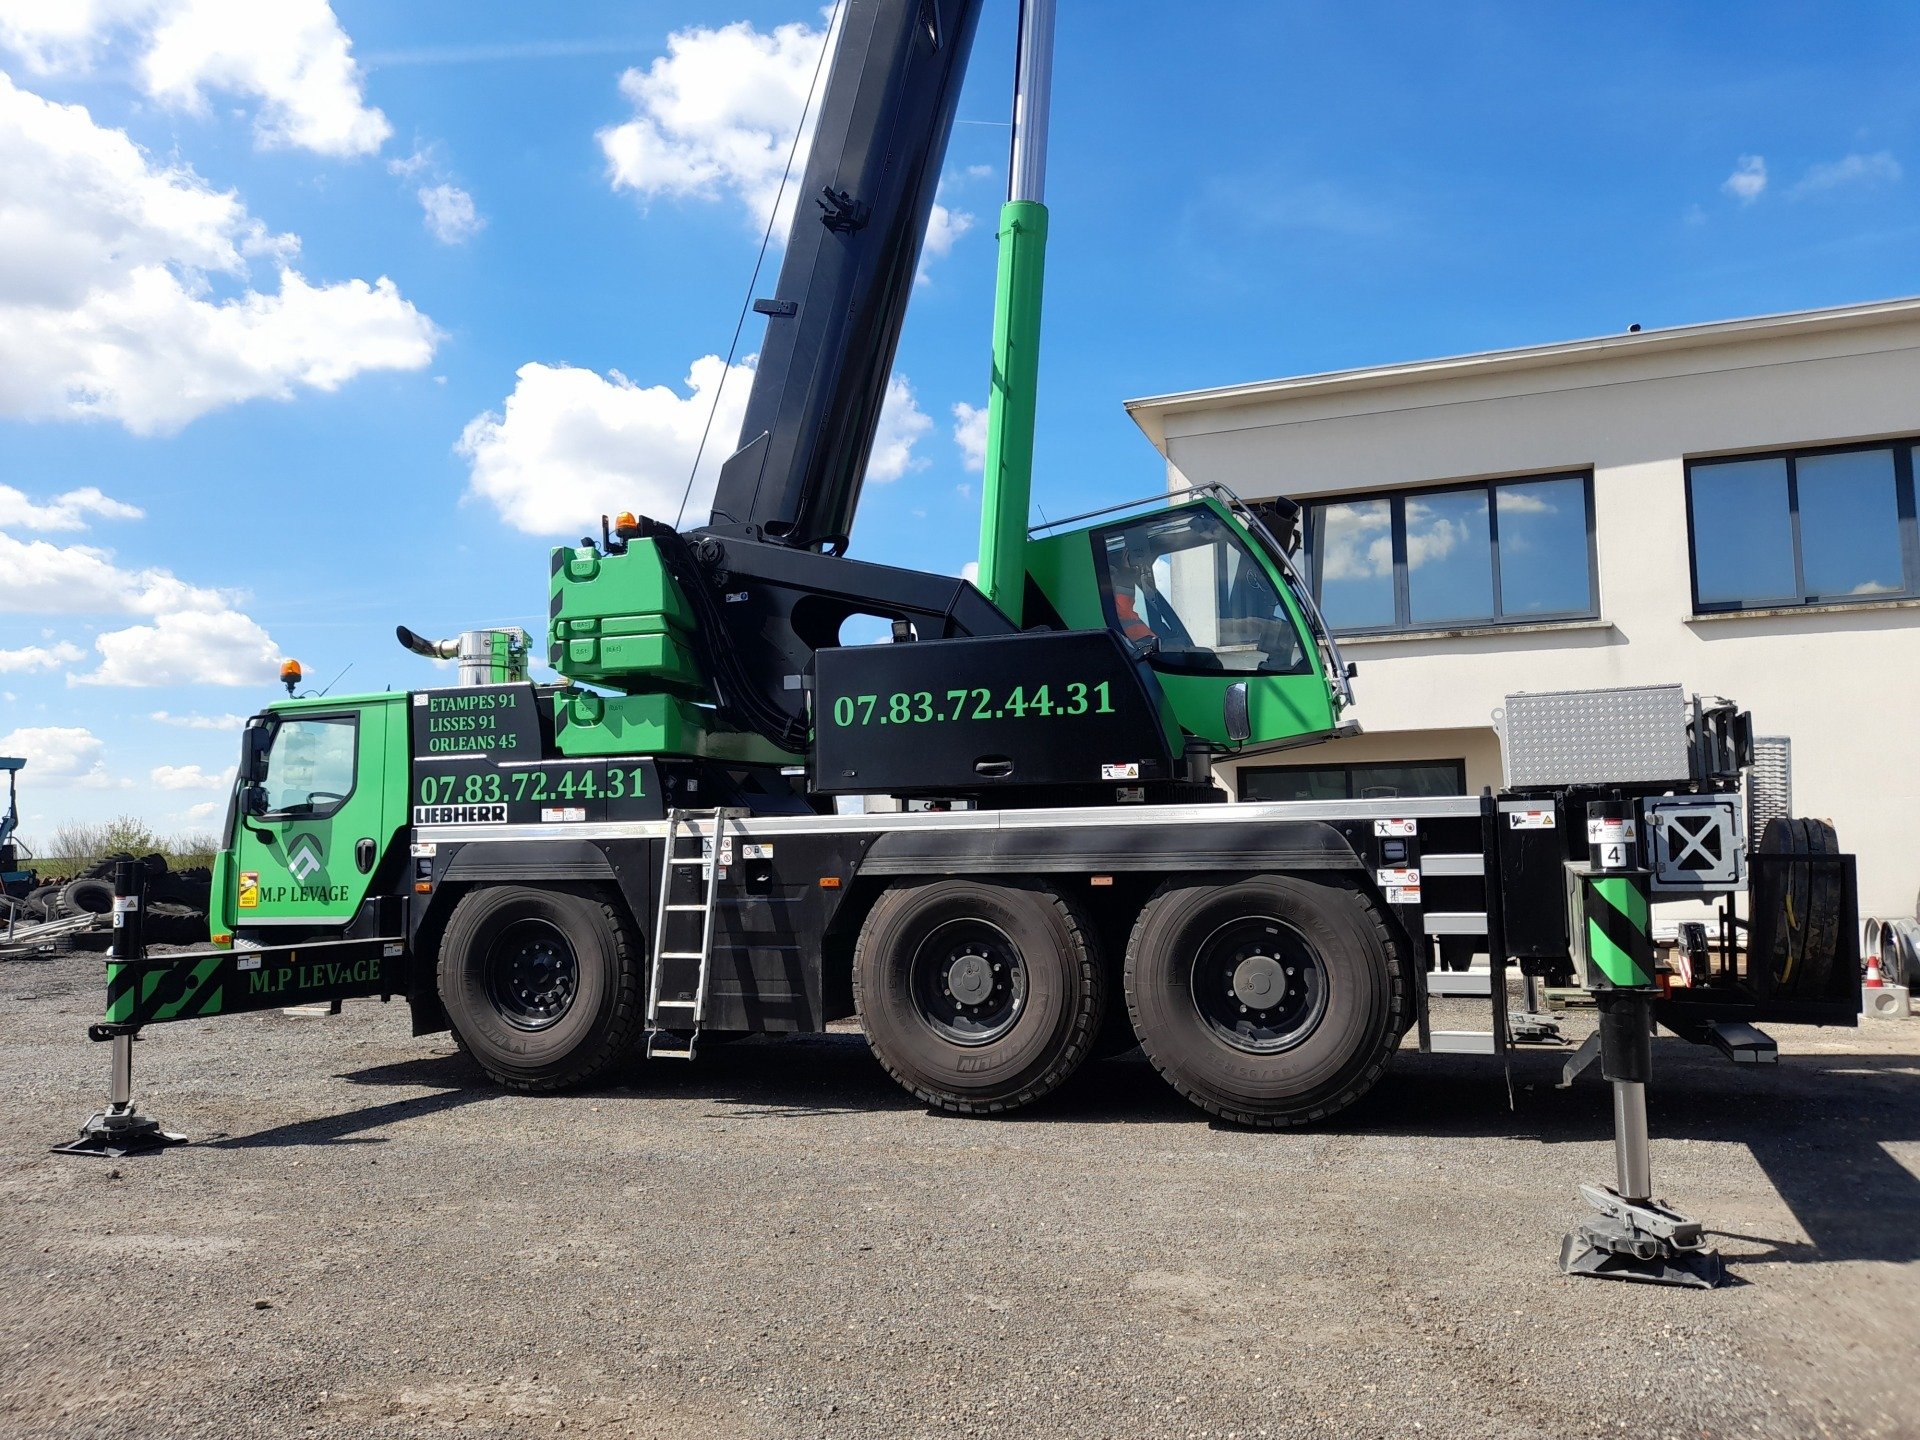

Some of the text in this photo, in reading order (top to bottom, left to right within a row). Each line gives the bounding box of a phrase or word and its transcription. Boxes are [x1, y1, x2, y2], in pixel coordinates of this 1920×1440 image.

[430, 695, 496, 712] ETAMPES
[498, 694, 517, 708] 91
[833, 680, 1116, 727] 07.83.72.44.31
[429, 715, 497, 732] LISSES 91
[429, 734, 517, 752] ORLEANS 45
[420, 768, 646, 805] 07.83.72.44.31
[415, 806, 505, 824] LIEBHERR
[1607, 846, 1621, 863] 4
[259, 885, 349, 903] M.P LEVAGE
[114, 913, 121, 926] 3
[249, 959, 381, 994] M.P LEVAGE
